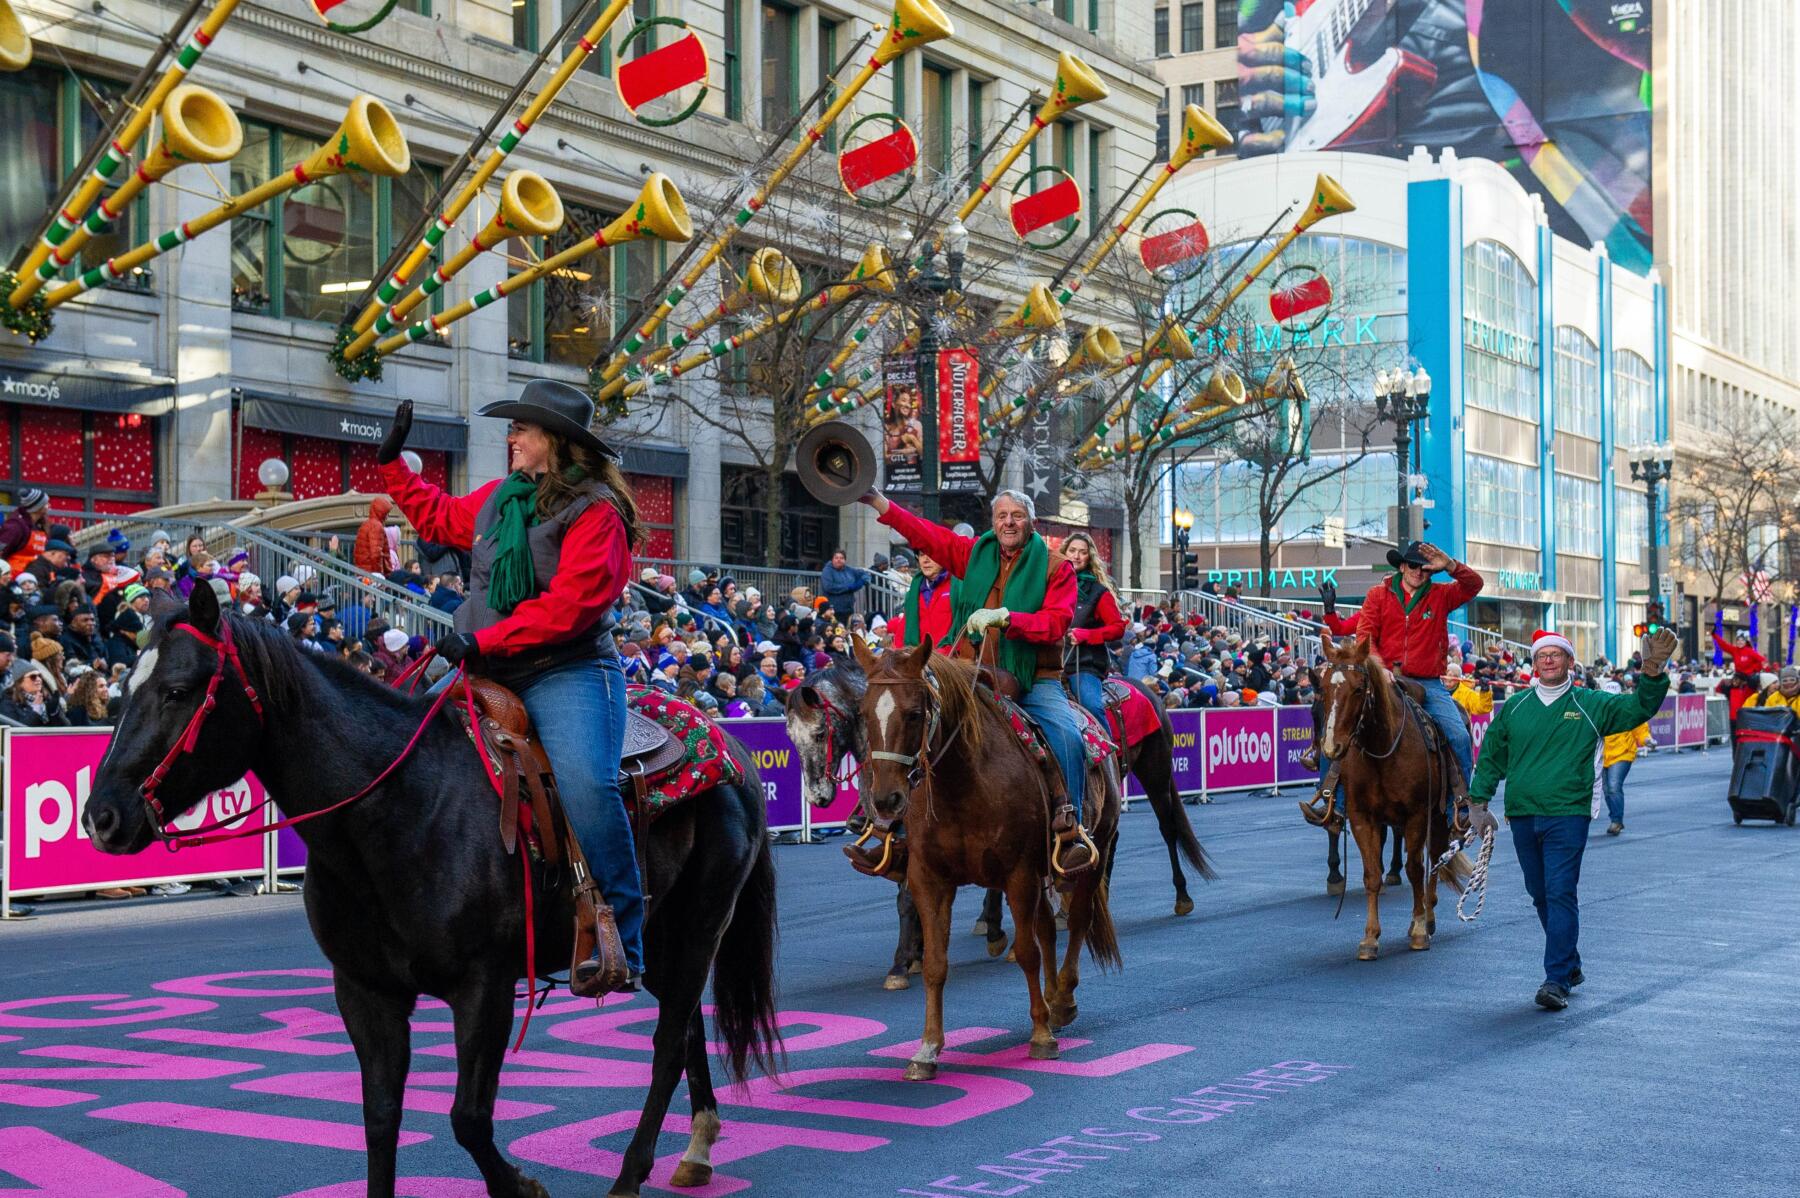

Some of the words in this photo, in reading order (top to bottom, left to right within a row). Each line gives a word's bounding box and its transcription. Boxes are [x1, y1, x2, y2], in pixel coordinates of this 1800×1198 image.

[949, 357, 967, 455] NUTCRACKER
[1173, 732, 1195, 748] NOW
[1282, 727, 1312, 742] STREAM
[751, 749, 790, 769] NOW
[1209, 726, 1259, 774] pluto
[1171, 757, 1189, 772] VER
[1125, 1059, 1356, 1124] GATHER
